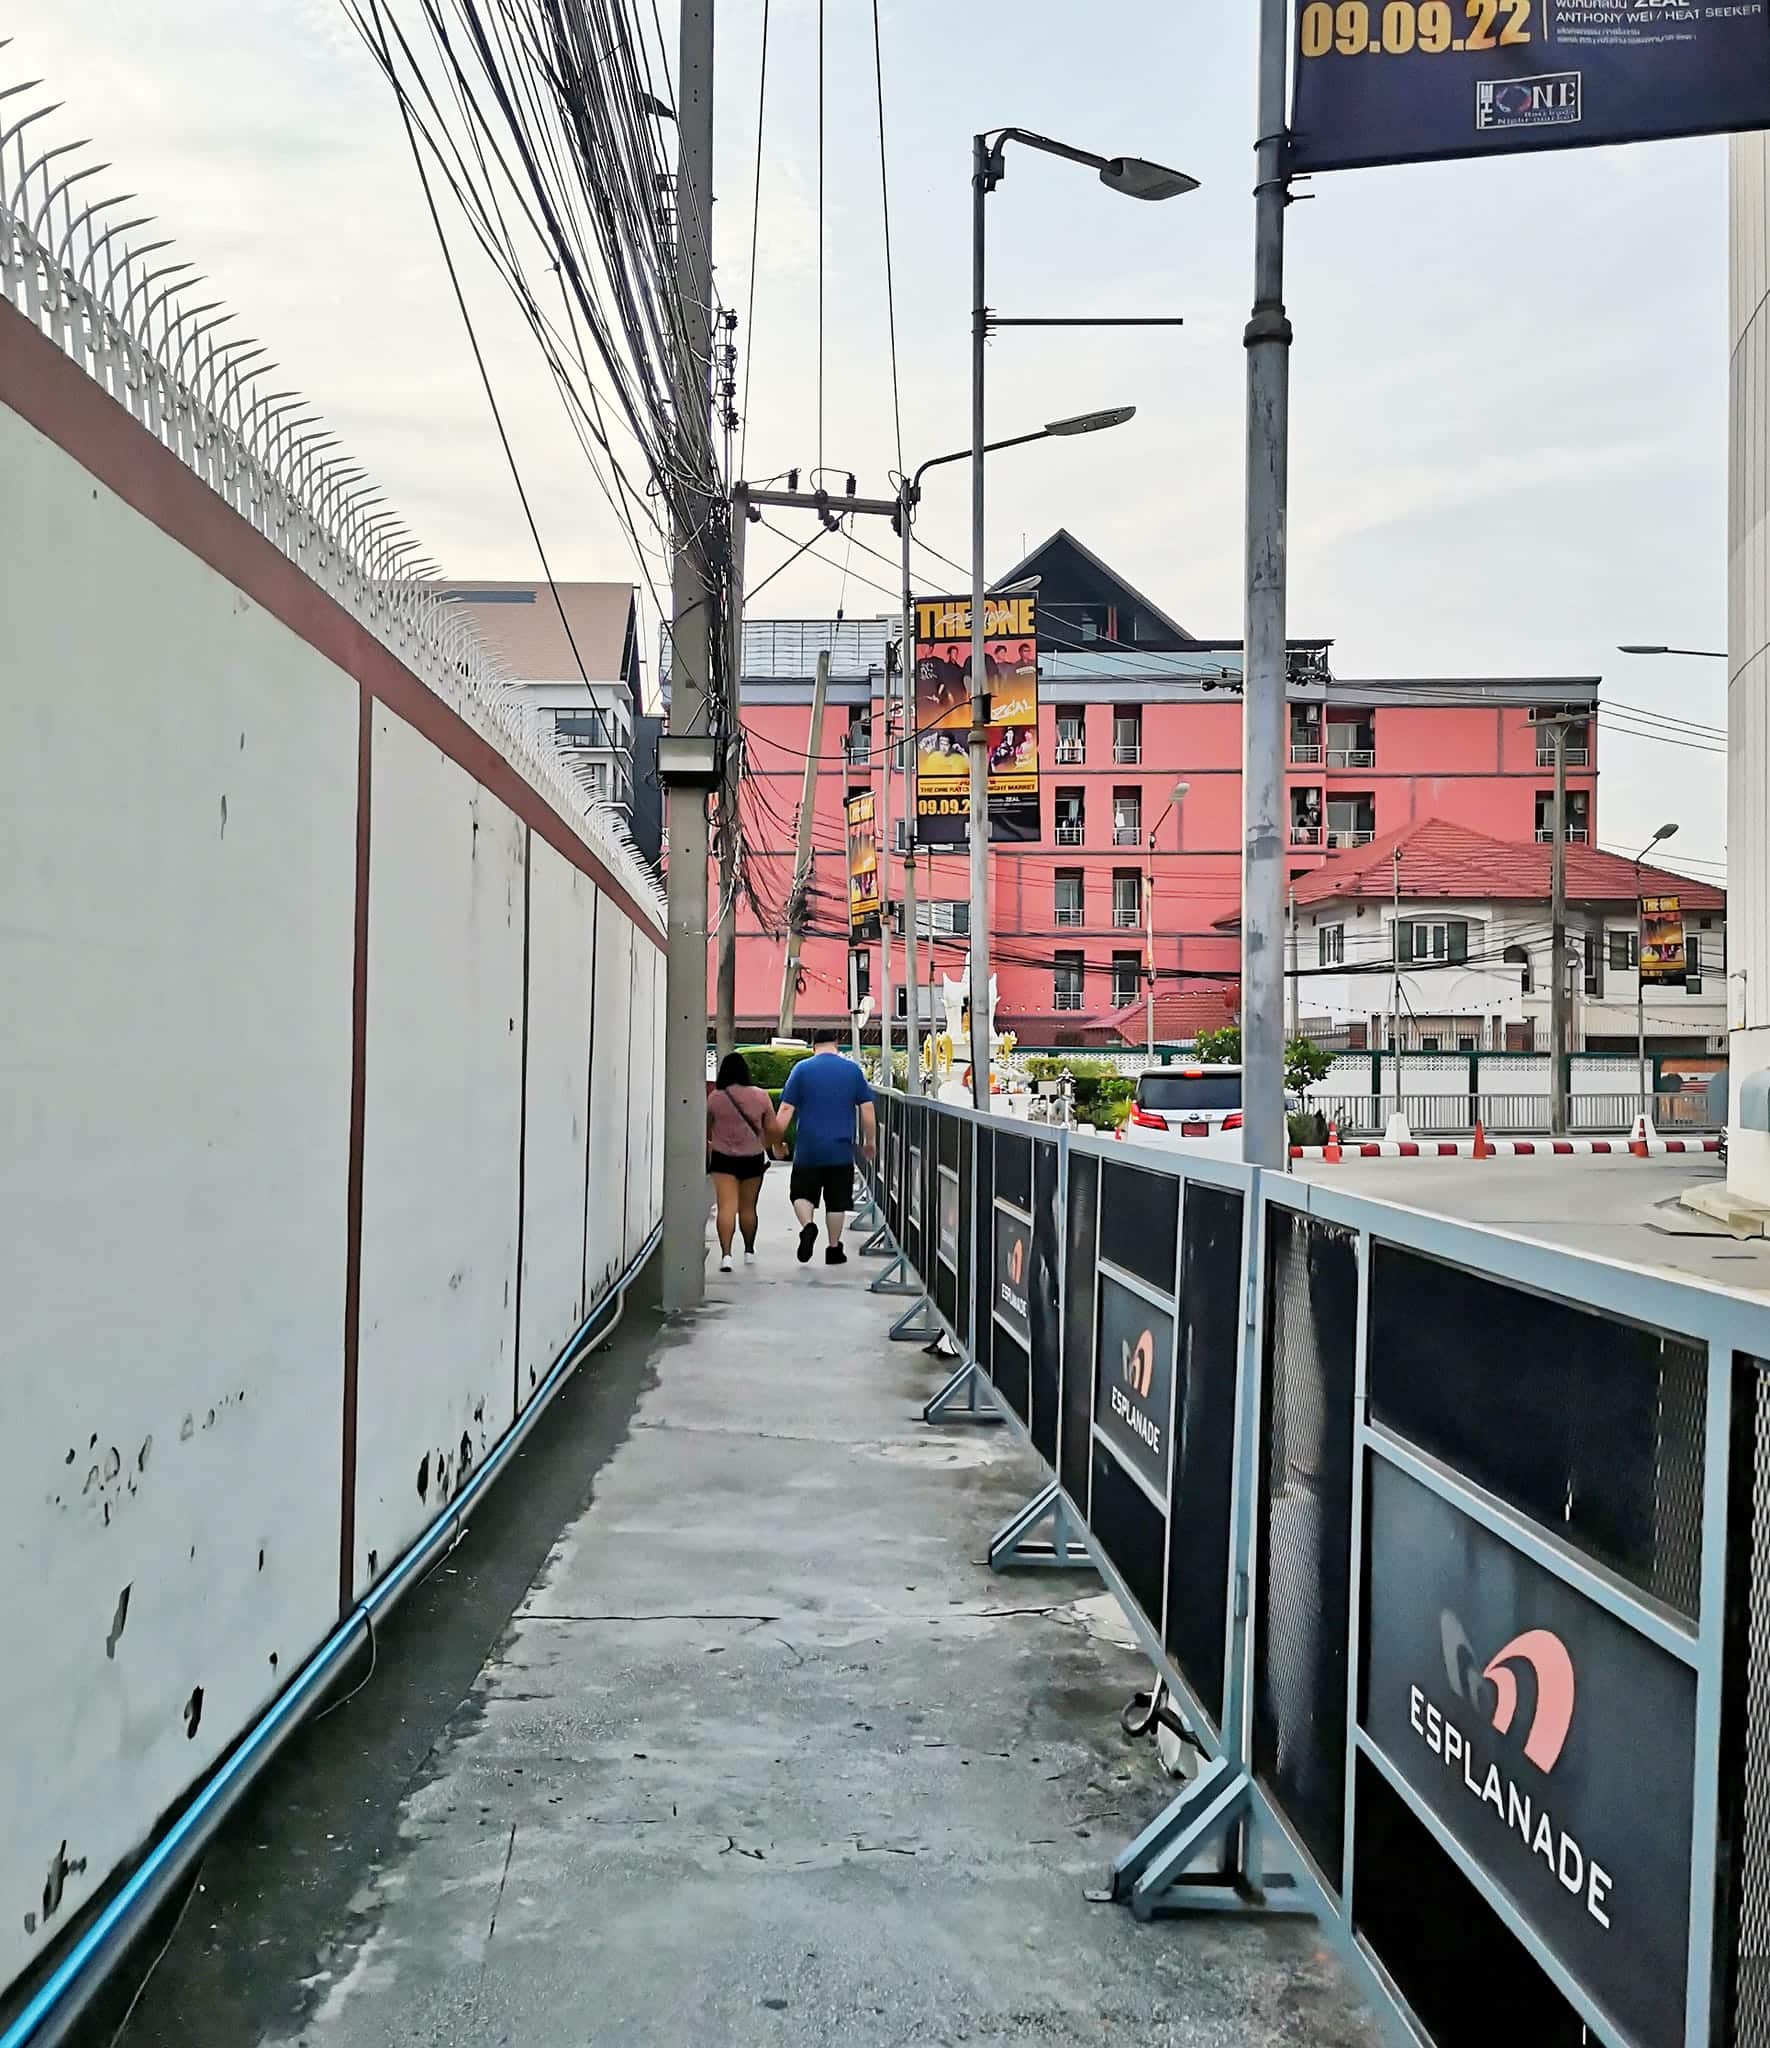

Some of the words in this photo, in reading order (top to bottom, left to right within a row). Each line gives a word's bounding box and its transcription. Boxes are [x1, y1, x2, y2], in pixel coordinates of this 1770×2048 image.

[1301, 0, 1531, 57] 09.09.22
[1555, 11, 1622, 23] ANTHONY
[1626, 11, 1653, 22] WEI
[1665, 8, 1700, 20] HEAT
[1705, 4, 1761, 18] SEEKER
[1481, 84, 1494, 128] THE
[1495, 82, 1576, 113] ONE
[916, 601, 973, 638] THE
[918, 799, 971, 816] 09.09.2
[1111, 1385, 1161, 1455] ESPLANADE
[1411, 1684, 1613, 1929] ESPLANADE
